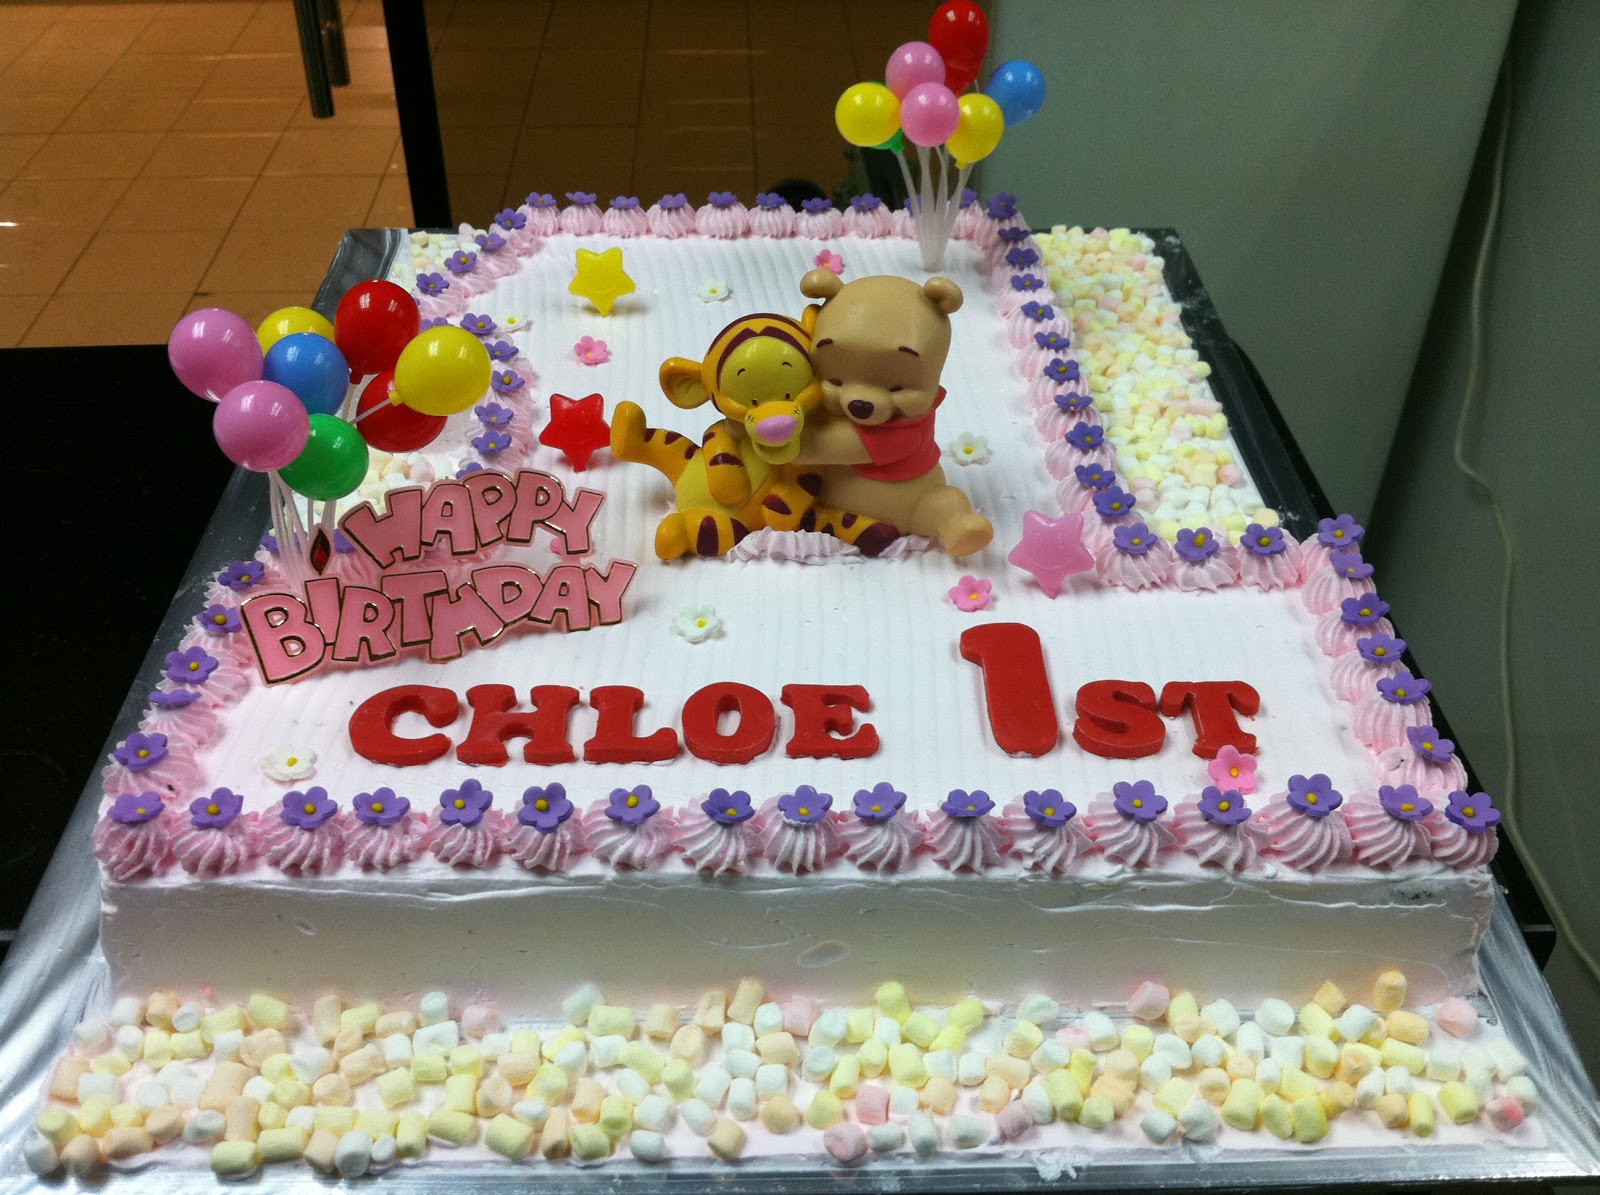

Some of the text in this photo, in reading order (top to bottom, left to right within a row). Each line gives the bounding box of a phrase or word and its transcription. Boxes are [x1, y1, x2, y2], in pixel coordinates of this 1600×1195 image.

[340, 470, 605, 569] HAPPY
[240, 560, 637, 684] BIRTHDAY
[348, 622, 1260, 766] CHLOE 1ST
